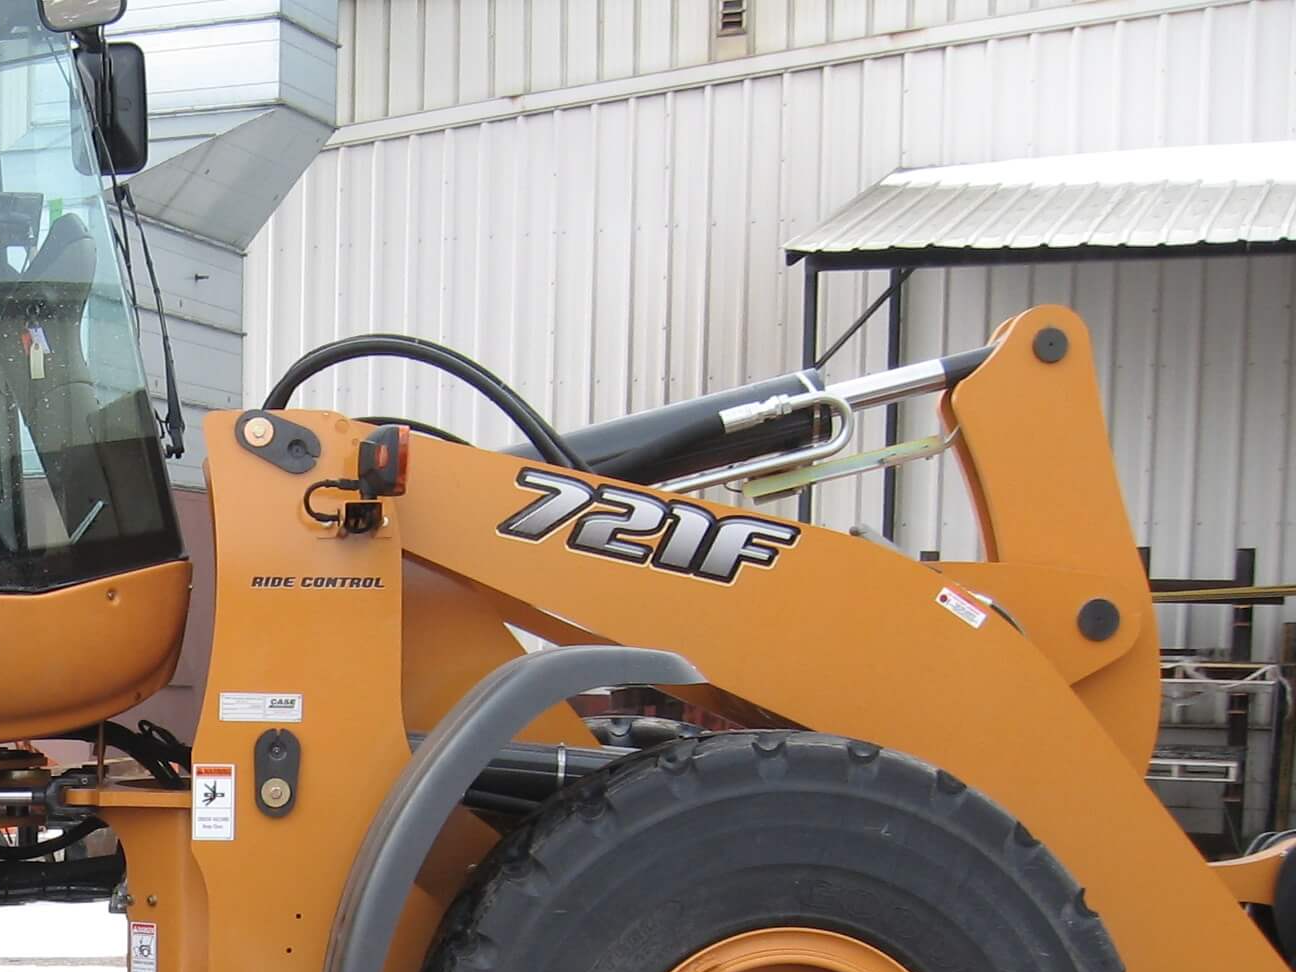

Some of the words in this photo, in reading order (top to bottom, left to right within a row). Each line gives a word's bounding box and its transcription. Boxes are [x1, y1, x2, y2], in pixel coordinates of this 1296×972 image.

[498, 468, 801, 582] 721F
[251, 576, 296, 588] RIDE
[300, 576, 385, 589] CONTROL
